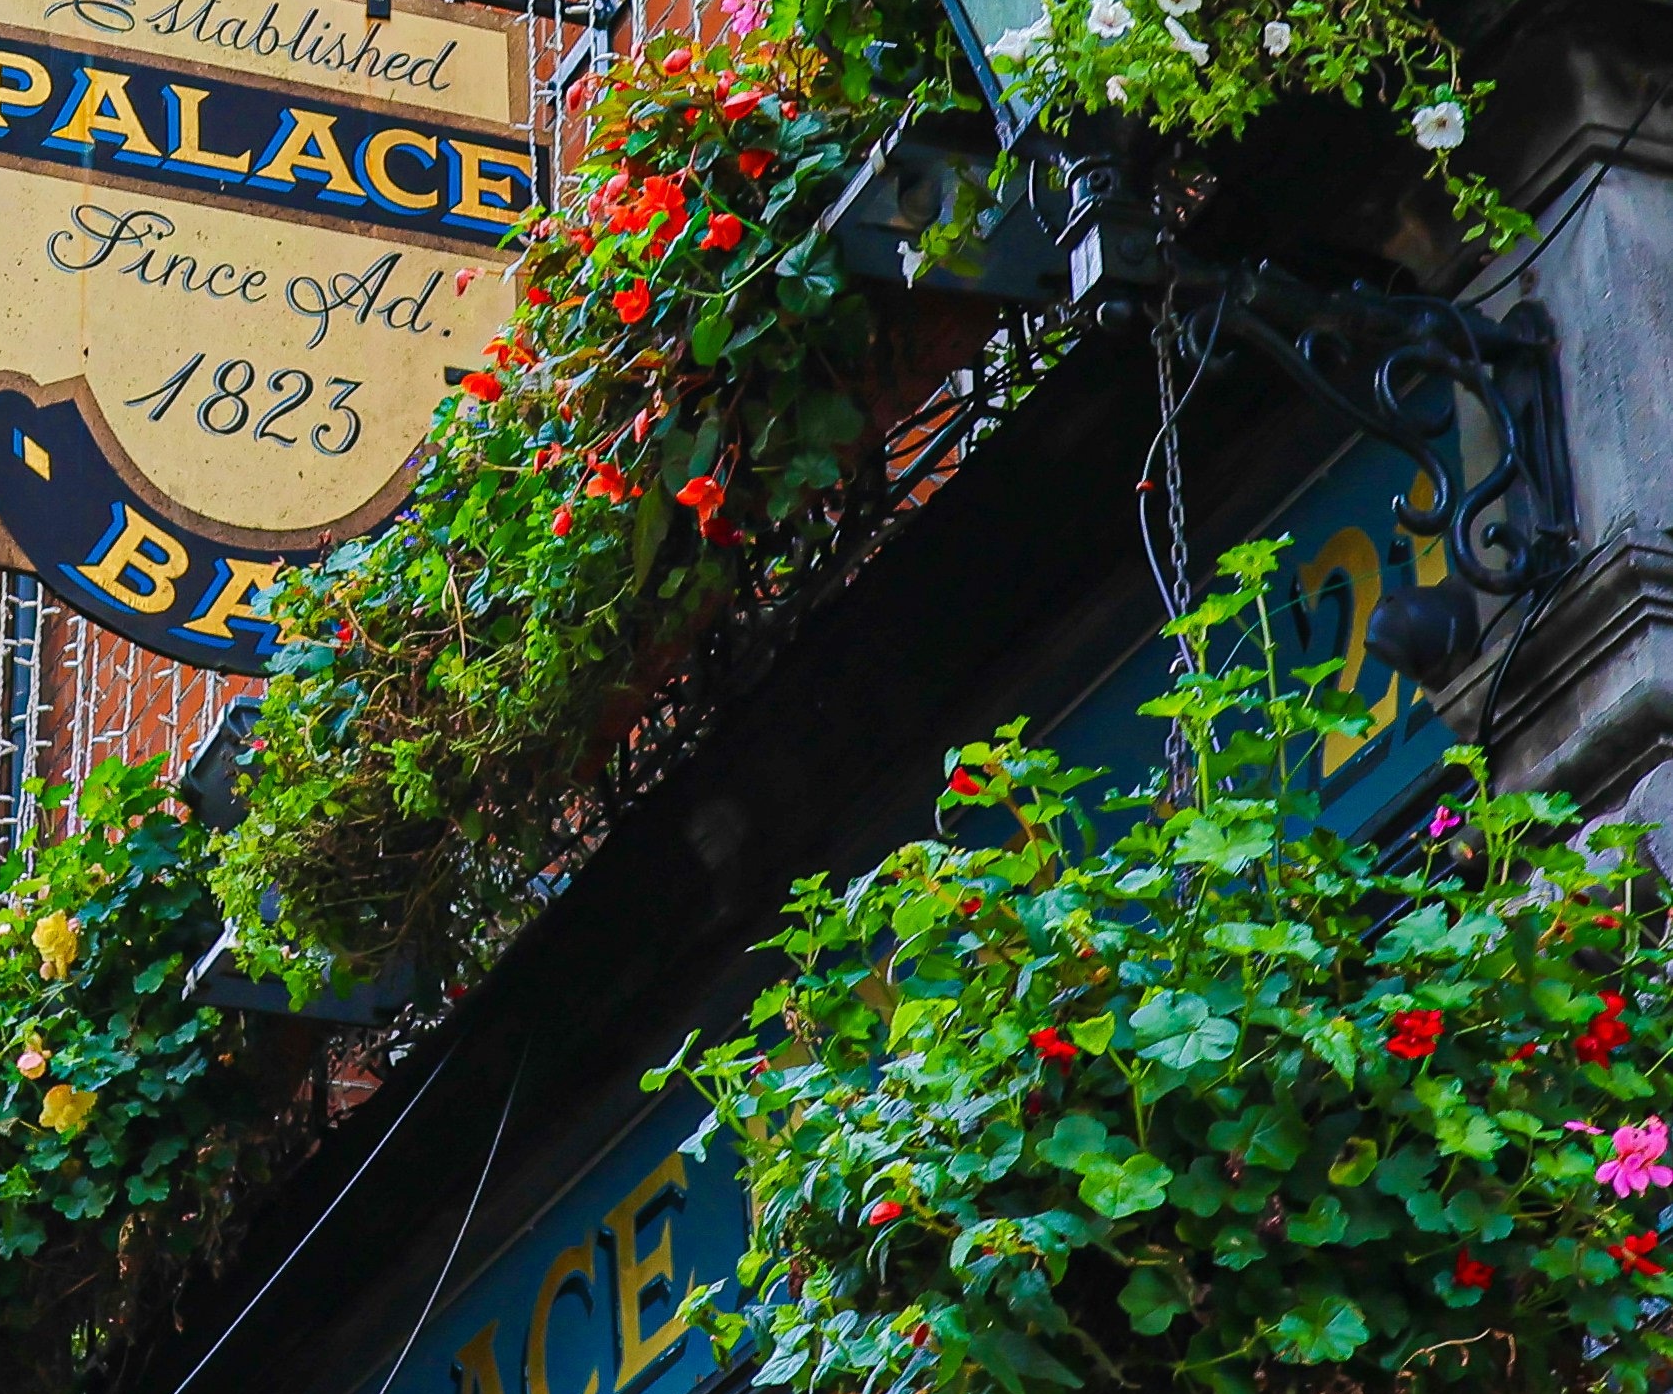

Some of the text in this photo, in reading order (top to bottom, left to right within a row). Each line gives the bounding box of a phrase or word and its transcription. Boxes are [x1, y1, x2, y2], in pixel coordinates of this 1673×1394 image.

[47, 204, 453, 350] Since Ad.
[124, 353, 364, 456] 1823
[58, 500, 313, 656] BA
